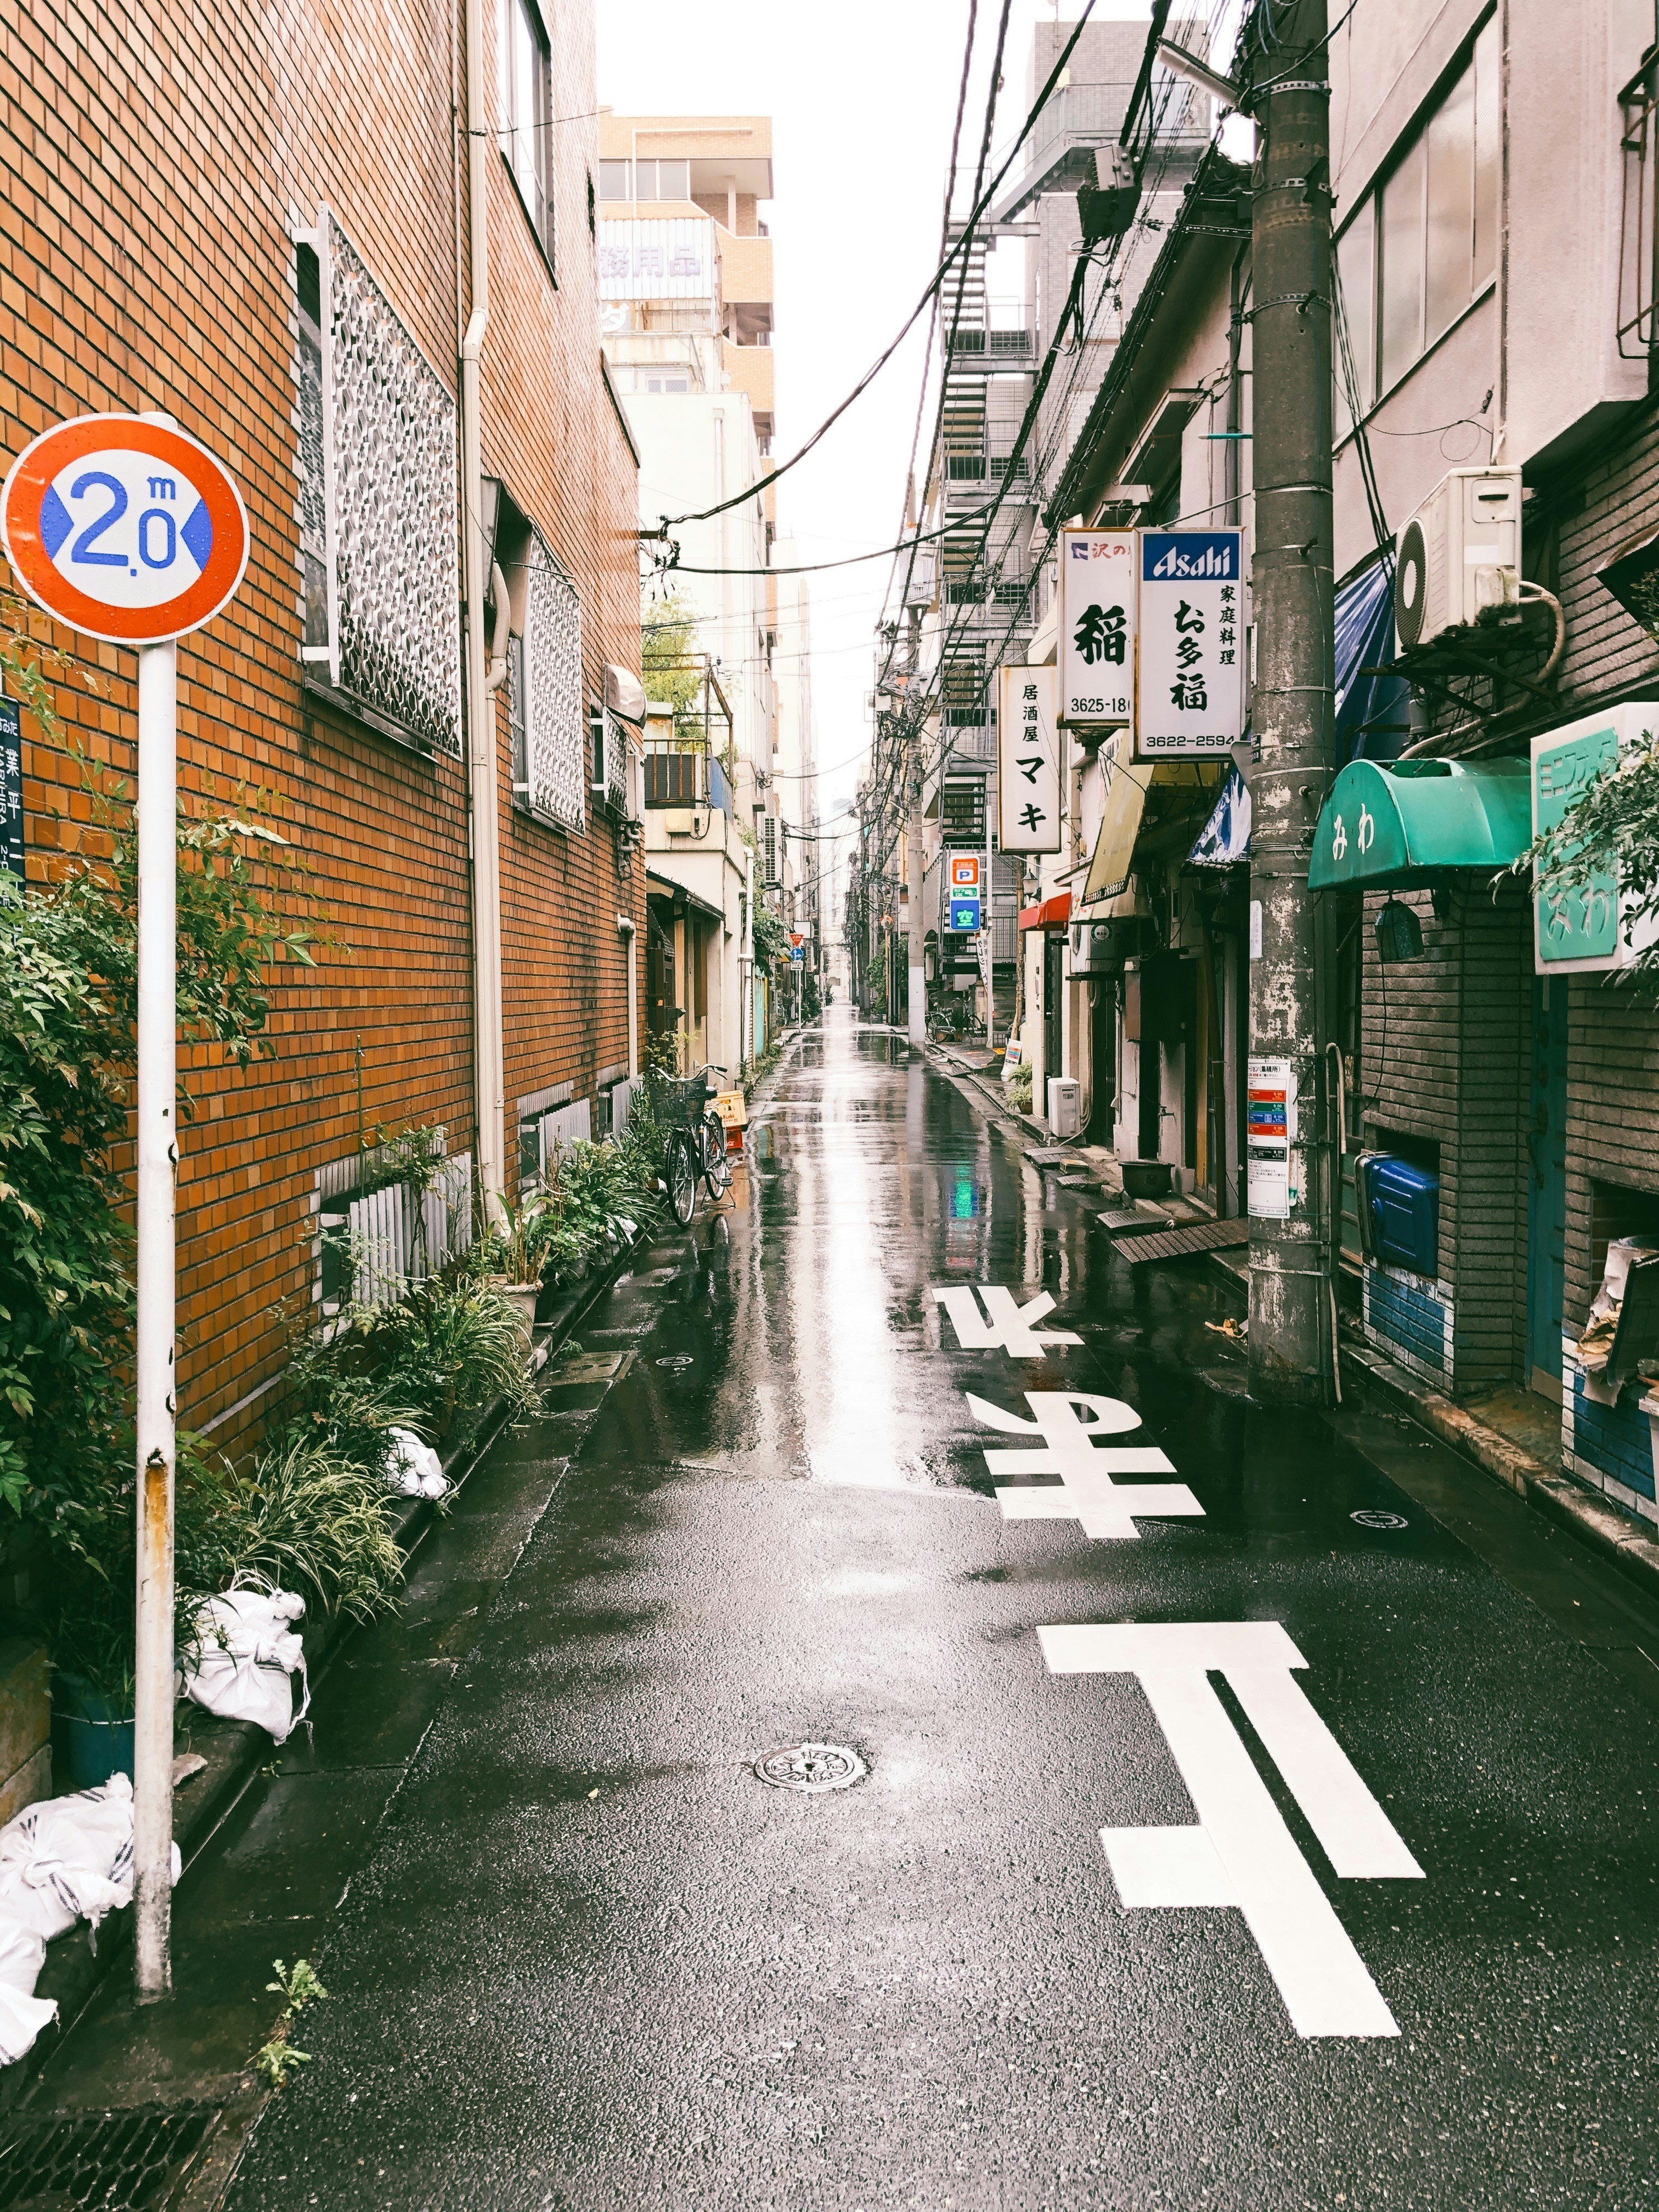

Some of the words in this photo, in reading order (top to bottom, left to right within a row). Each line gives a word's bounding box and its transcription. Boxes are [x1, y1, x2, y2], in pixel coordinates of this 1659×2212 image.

[70, 471, 177, 577] 2.0
[1091, 542, 1131, 559] 沢の
[1153, 546, 1231, 578] Asahi
[1074, 603, 1127, 666] 稲
[1218, 585, 1236, 666] 家庭料理
[1170, 599, 1208, 712] お多福
[1022, 684, 1040, 743] 居酒屋
[1146, 735, 1235, 748] 3622-2594
[1015, 756, 1047, 833] マキ
[1332, 803, 1375, 861] みわ
[960, 871, 970, 879] P
[957, 909, 974, 927] 空
